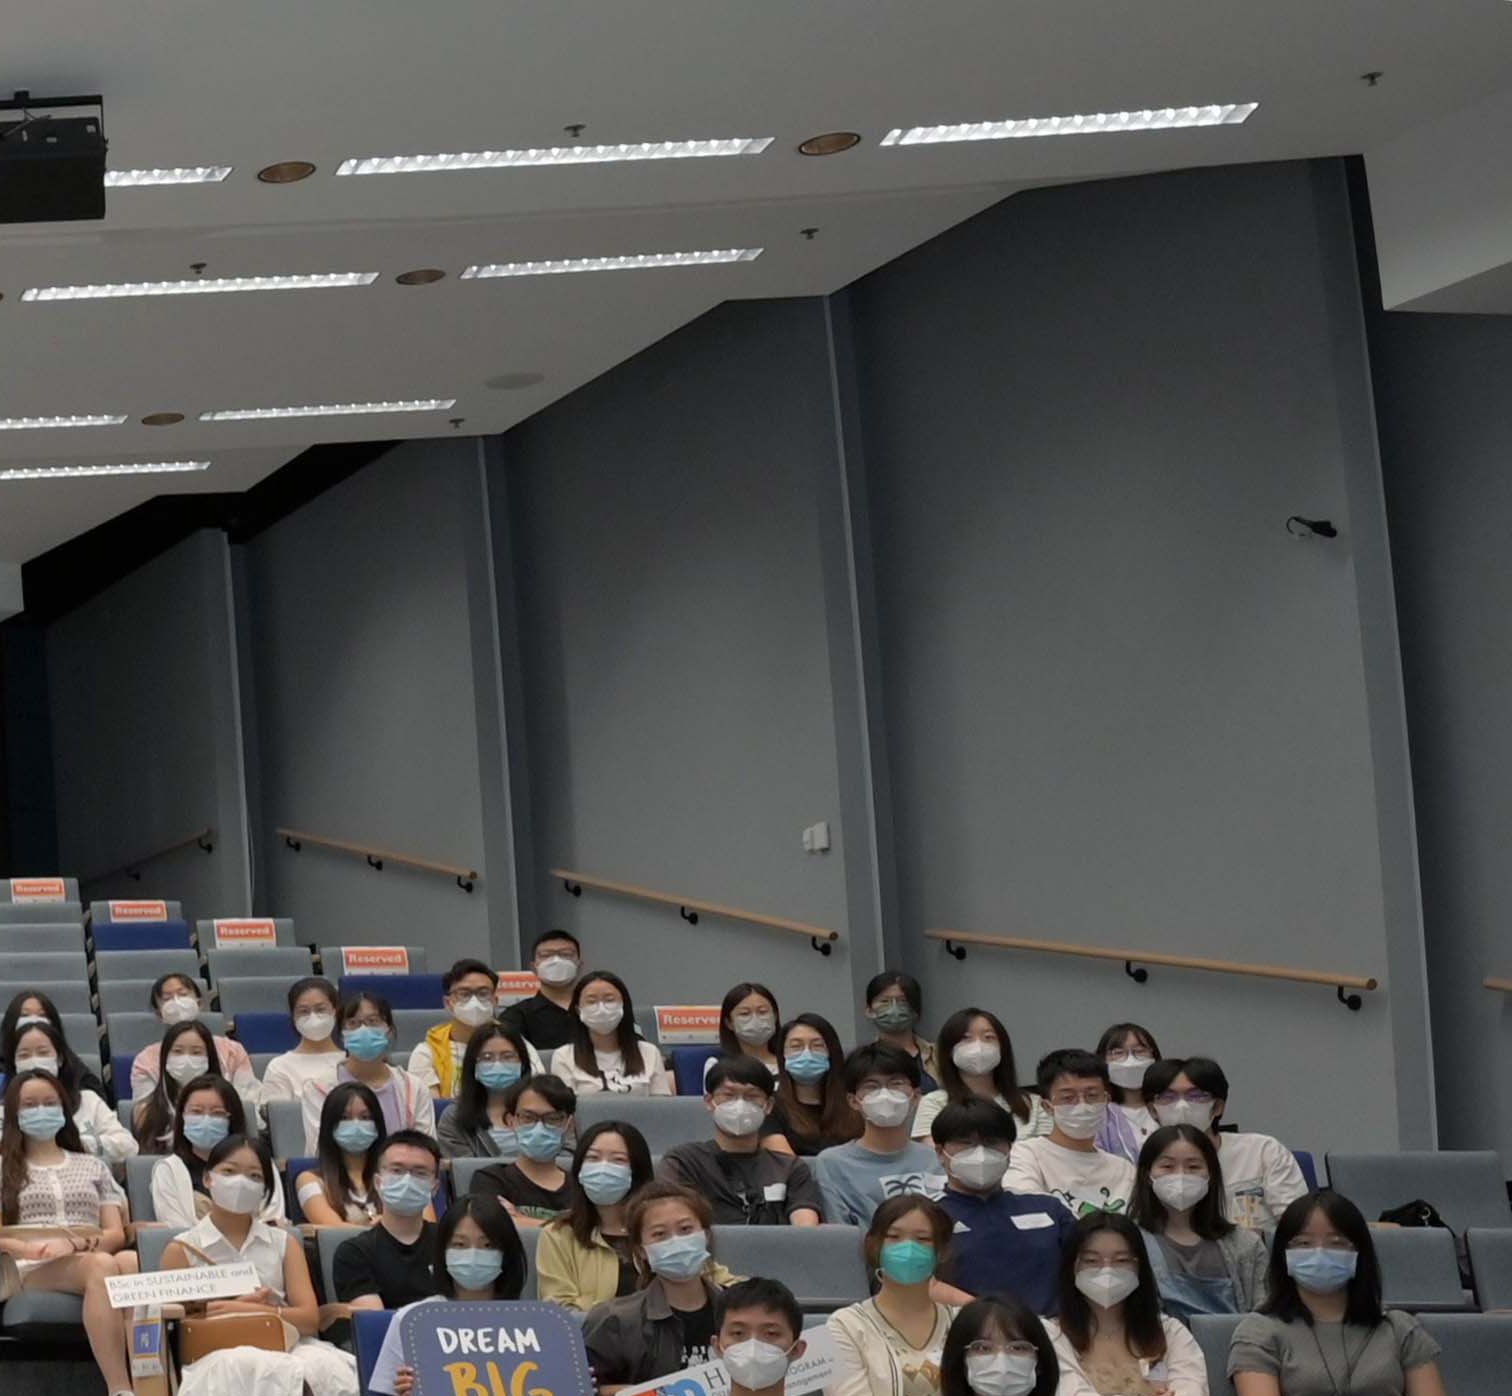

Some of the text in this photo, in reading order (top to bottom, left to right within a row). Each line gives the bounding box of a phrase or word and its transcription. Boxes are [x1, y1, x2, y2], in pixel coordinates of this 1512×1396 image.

[347, 954, 401, 966] Reserved
[231, 1266, 254, 1278] and
[436, 1327, 542, 1355] DREAM
